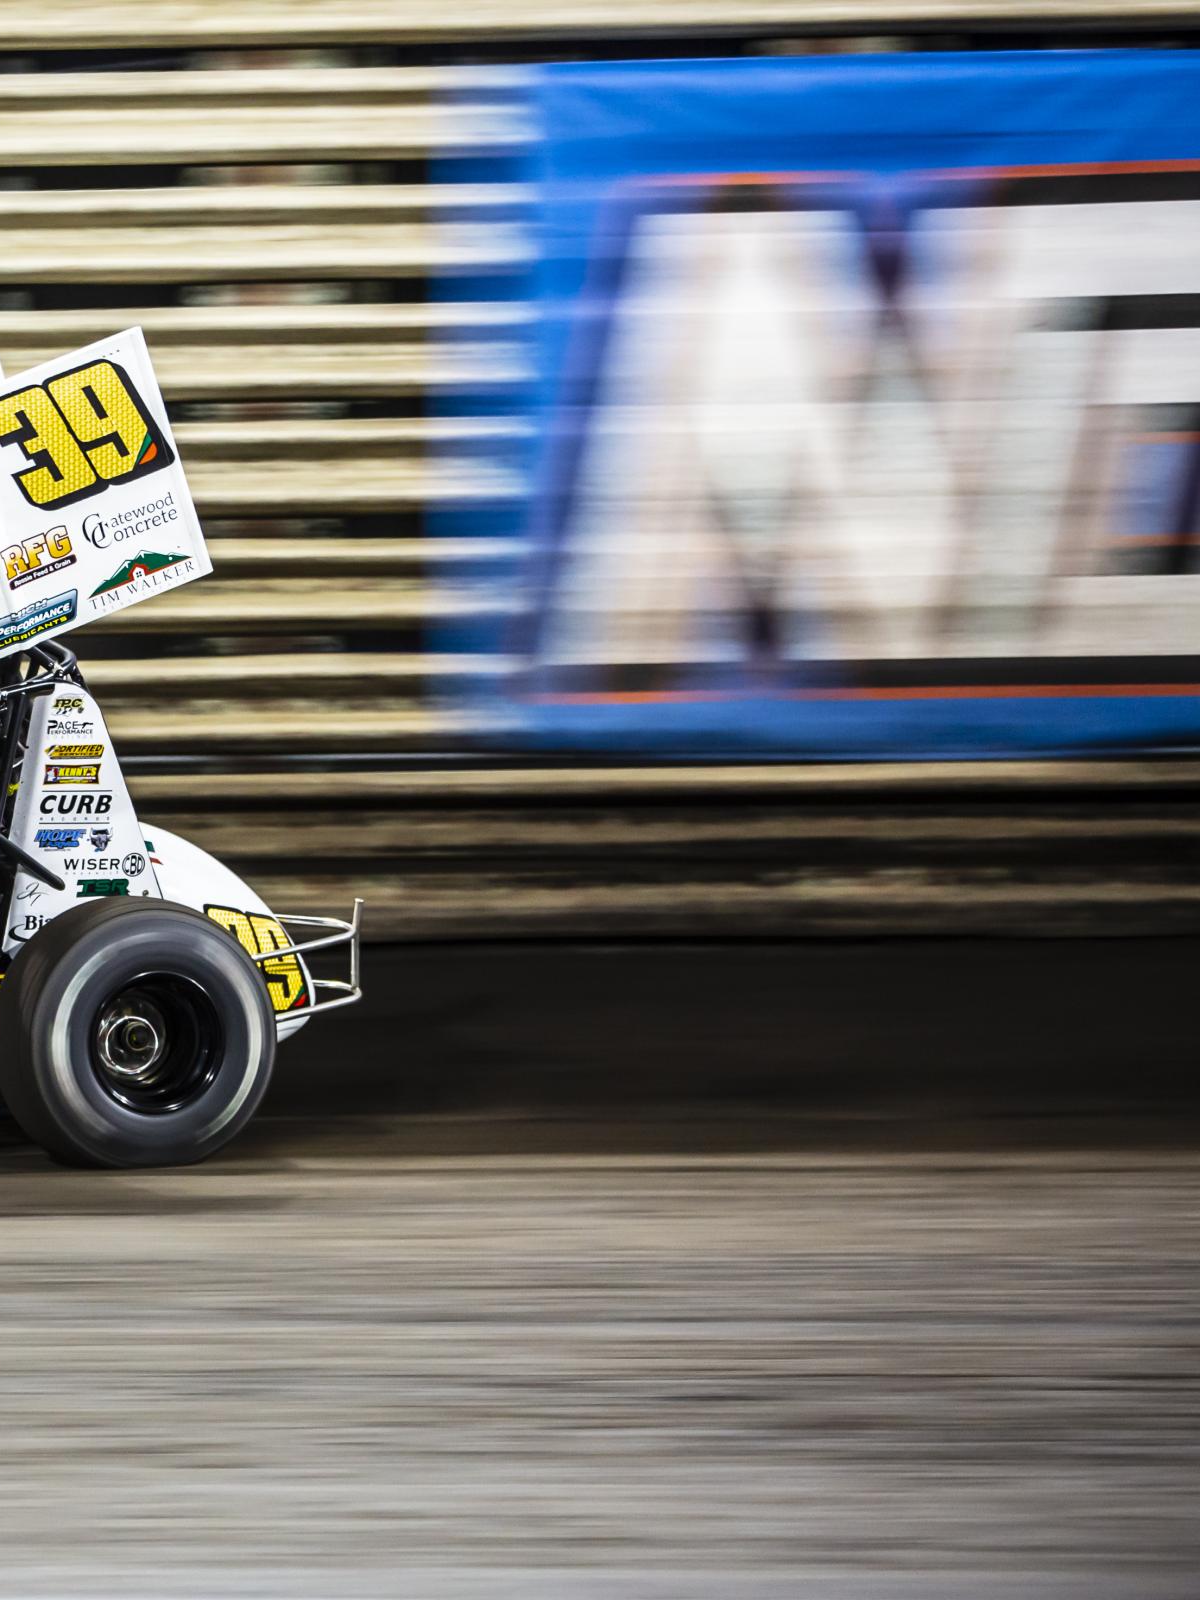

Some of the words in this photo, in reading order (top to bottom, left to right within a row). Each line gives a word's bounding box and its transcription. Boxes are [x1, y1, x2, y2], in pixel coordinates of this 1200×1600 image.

[82, 492, 174, 543] Gatewood
[91, 508, 179, 549] Concrete
[0, 525, 73, 580] RFG
[91, 591, 120, 610] TIM
[127, 561, 195, 594] WALKER
[40, 795, 113, 814] CURB
[64, 858, 120, 870] WISER
